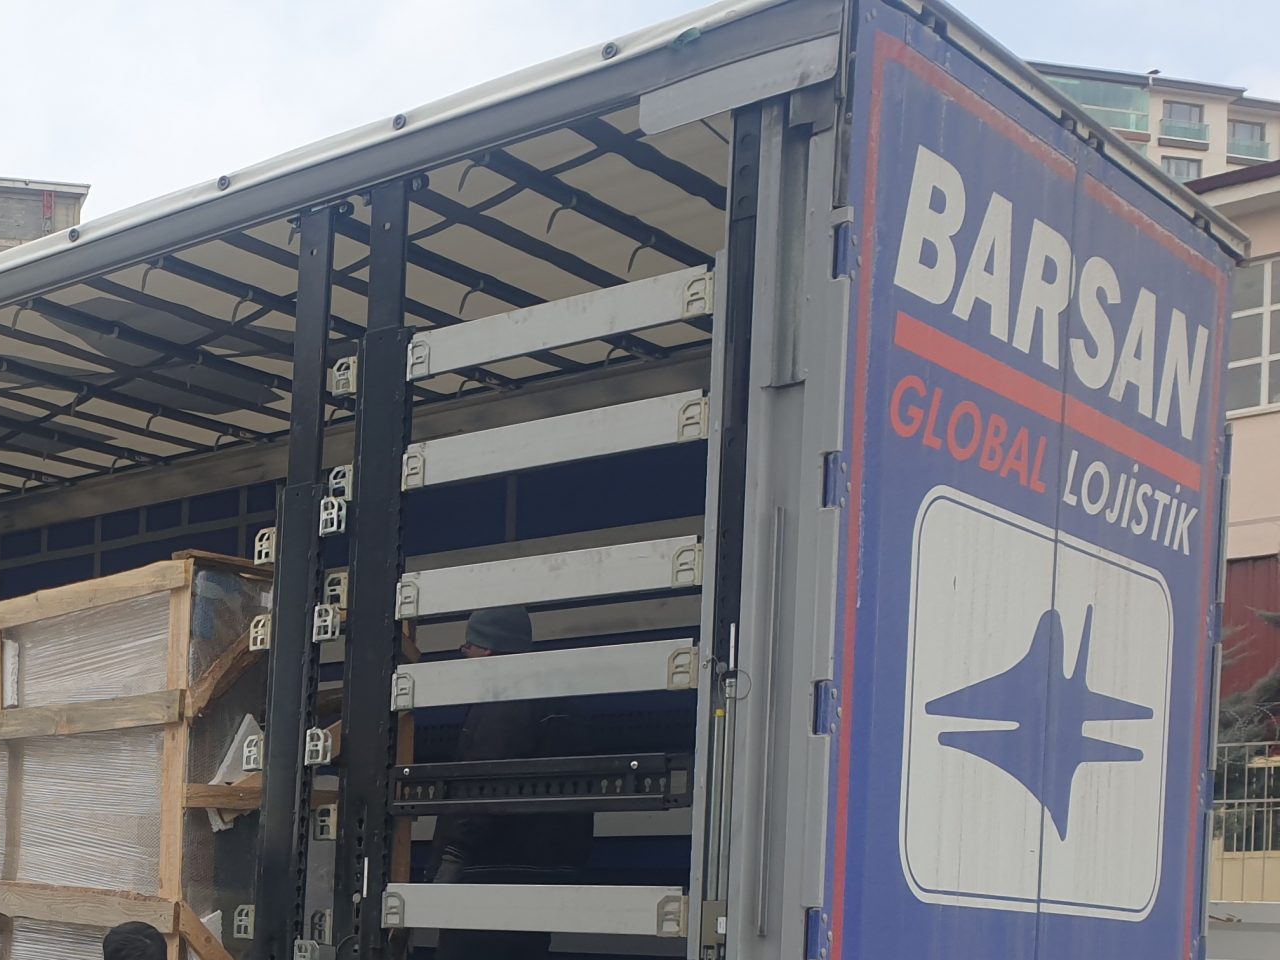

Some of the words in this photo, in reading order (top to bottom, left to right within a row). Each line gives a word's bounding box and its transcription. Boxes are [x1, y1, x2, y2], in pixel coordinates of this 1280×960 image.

[894, 144, 1209, 441] BARSAN
[889, 375, 1047, 493] GLOBAL
[1063, 449, 1199, 556] LOJİSTİK
